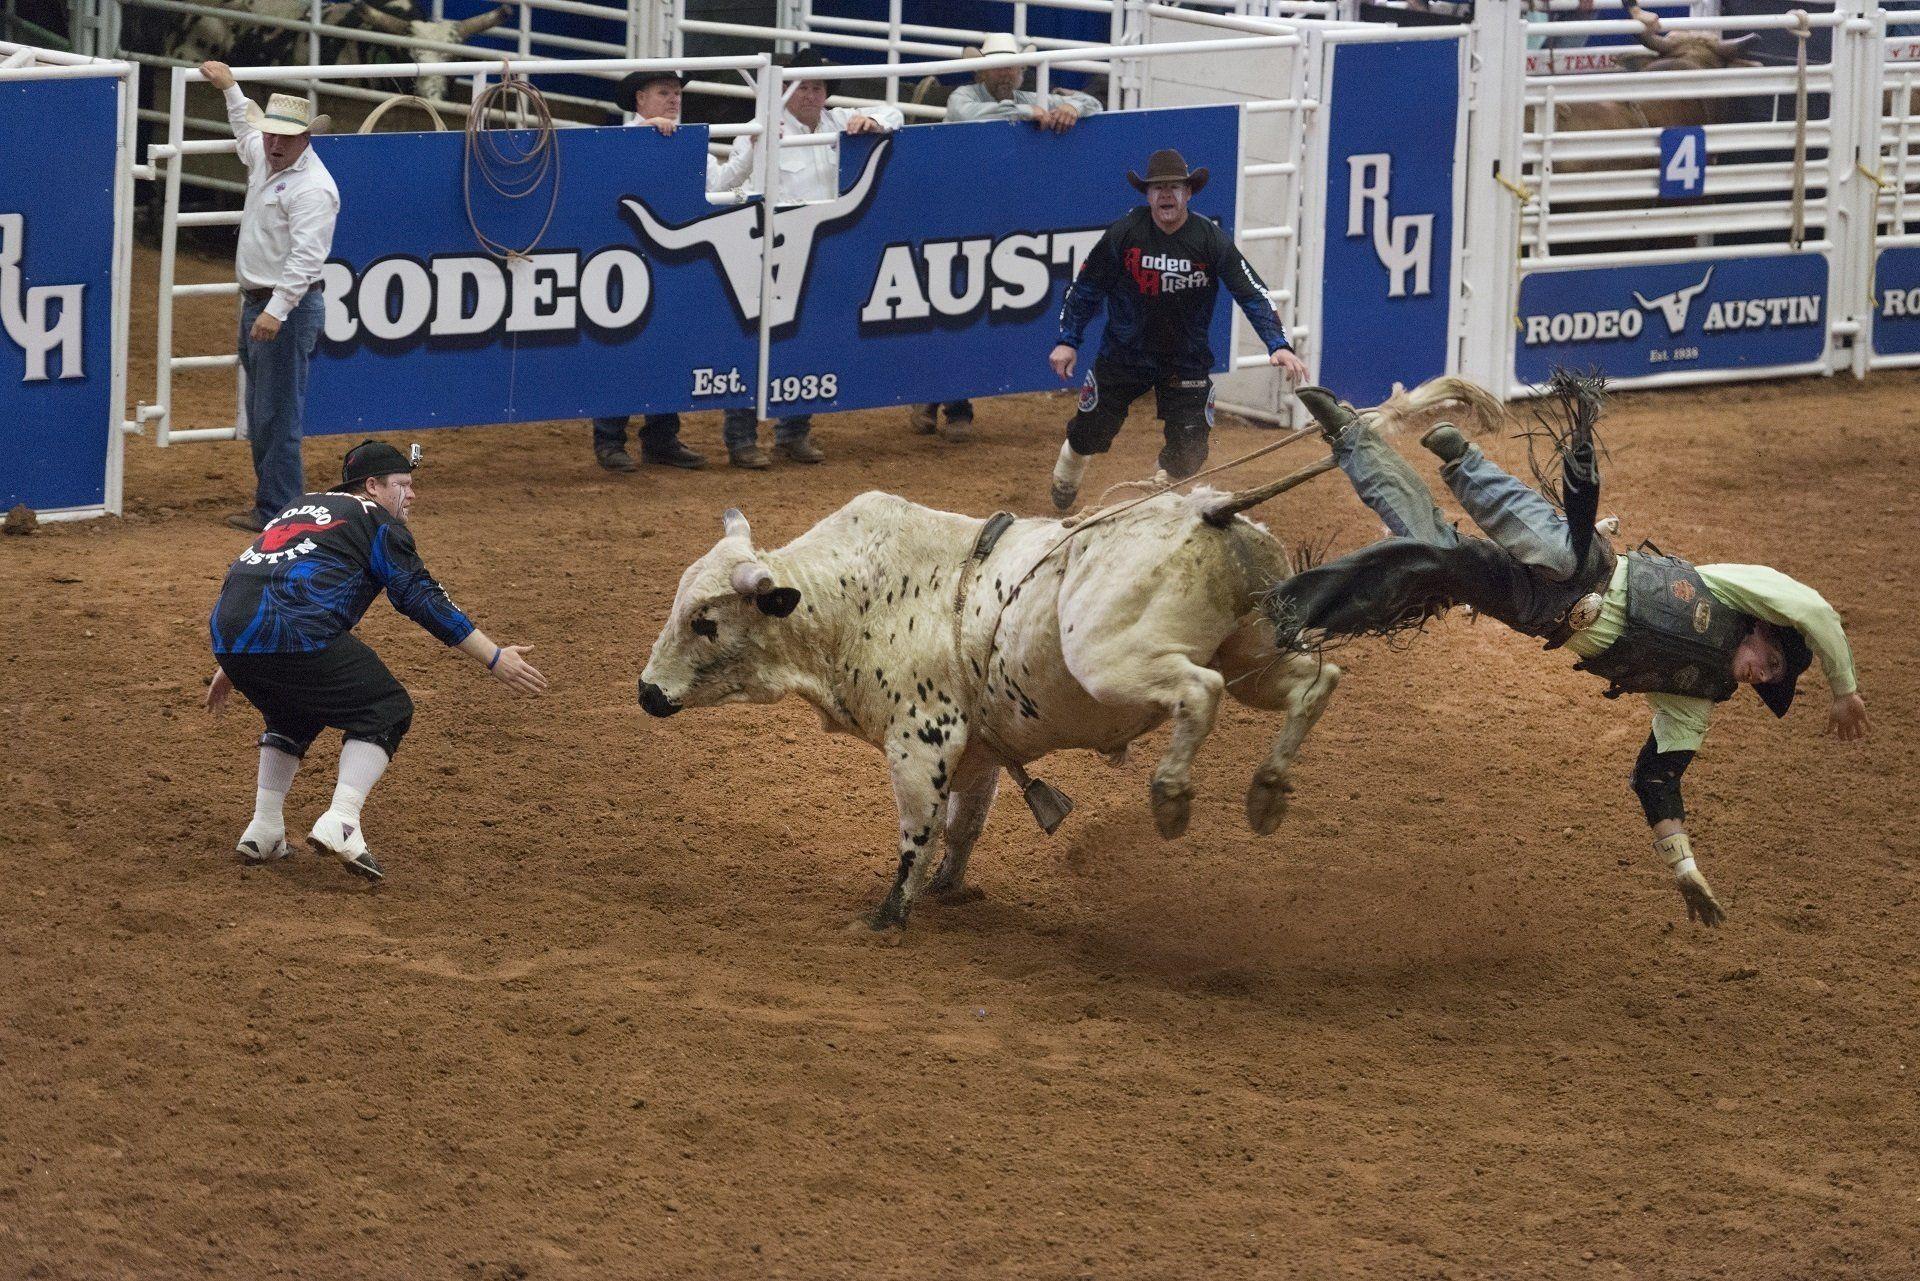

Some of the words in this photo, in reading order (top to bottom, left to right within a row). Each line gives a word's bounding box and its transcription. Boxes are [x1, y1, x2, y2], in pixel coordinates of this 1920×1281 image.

[1666, 134, 1700, 190] 4
[861, 229, 1107, 322] AUST
[1526, 308, 1643, 344] RODEO
[1703, 295, 1821, 332] AUSTIN
[692, 367, 747, 396] Est.
[769, 373, 838, 402] 1938
[240, 537, 318, 565] USTIN
